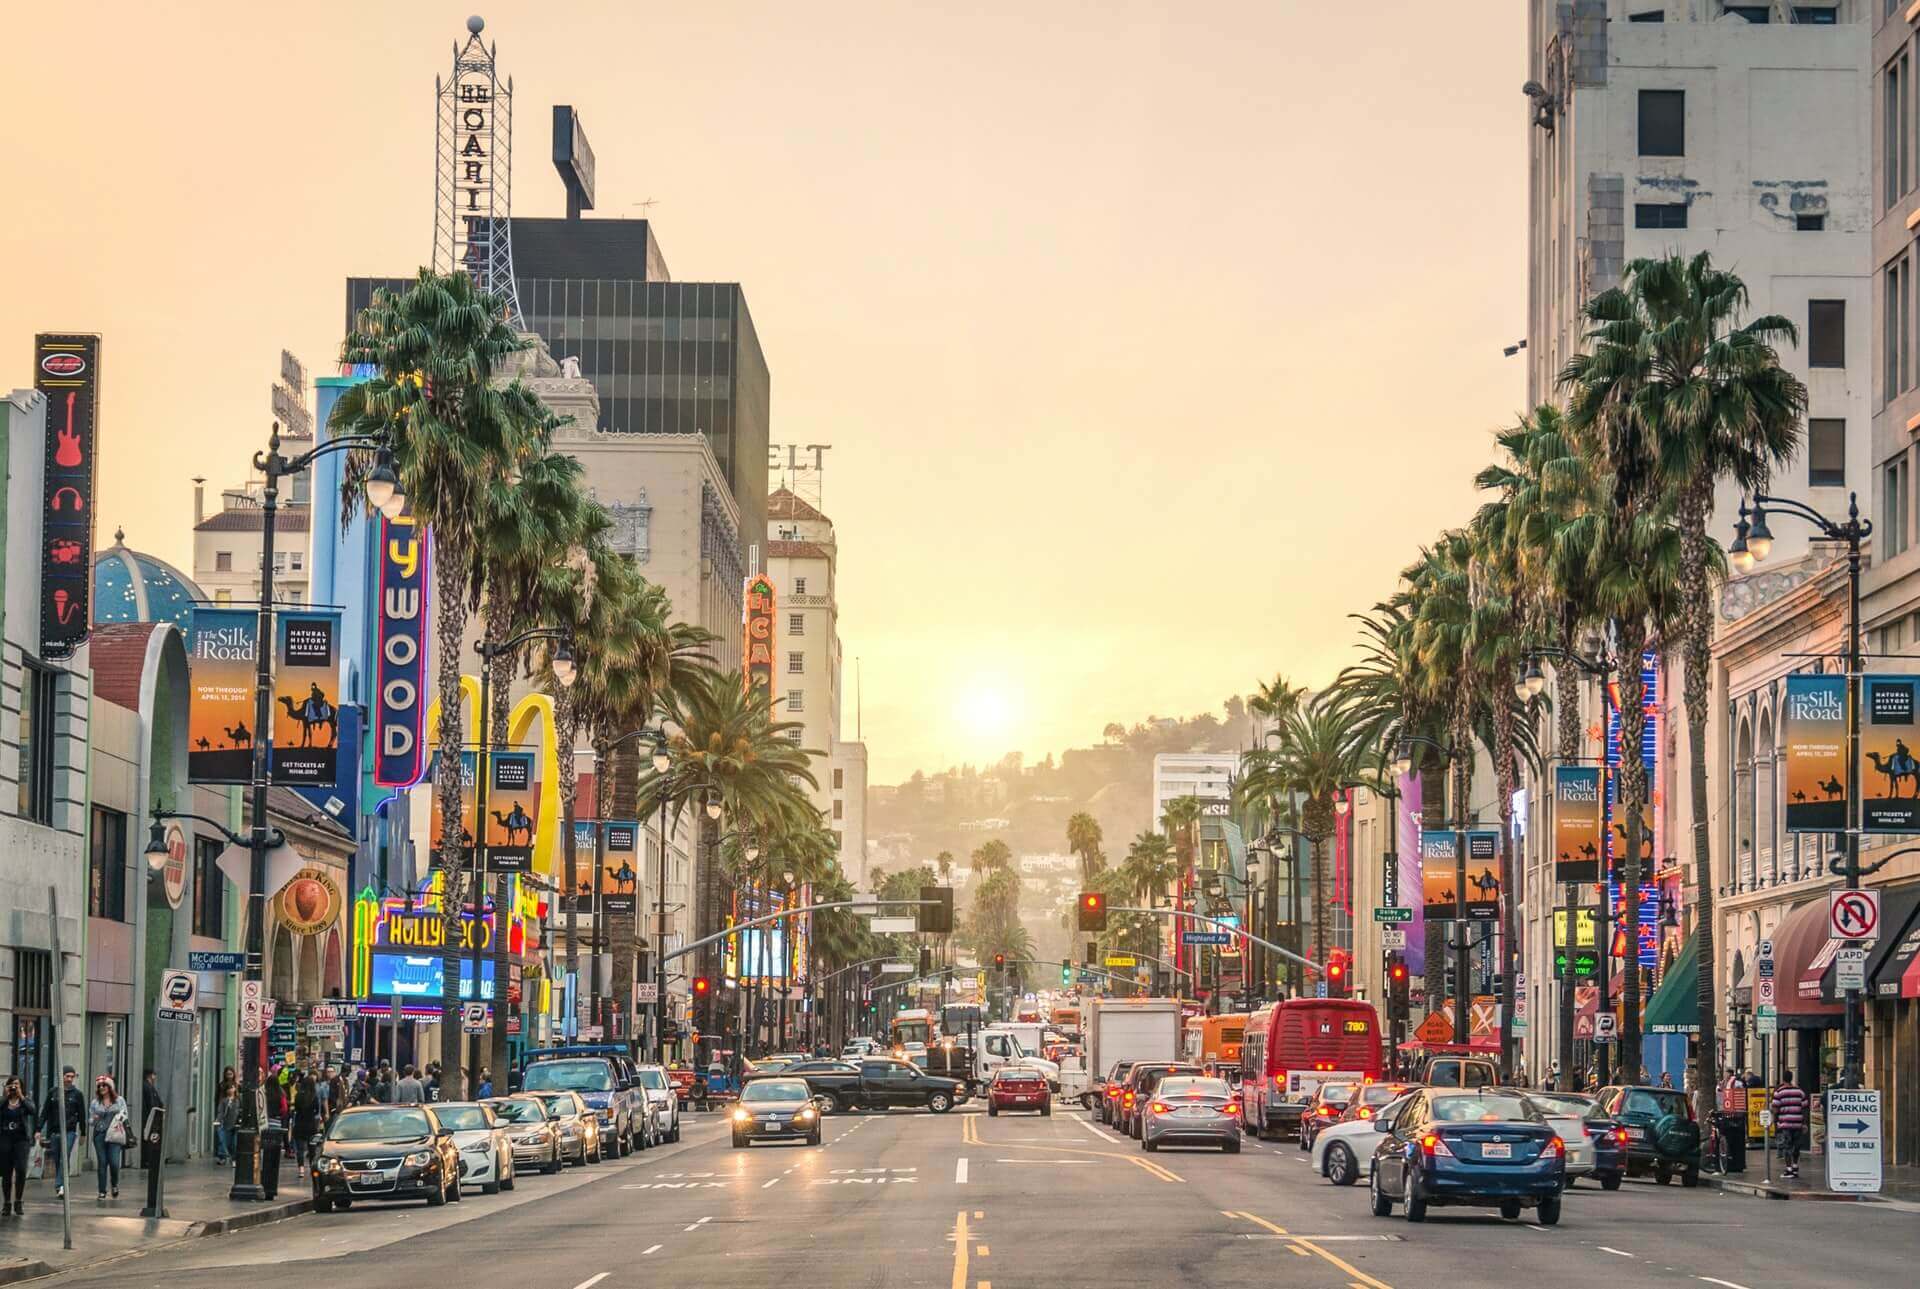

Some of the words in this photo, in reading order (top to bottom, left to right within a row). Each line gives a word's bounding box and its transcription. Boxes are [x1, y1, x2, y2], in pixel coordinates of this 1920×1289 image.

[751, 593, 771, 614] EL
[205, 630, 217, 640] The
[217, 627, 249, 646] Silk
[203, 640, 254, 660] Road
[1808, 690, 1838, 708] Silk
[1796, 702, 1843, 720] Road
[1572, 779, 1594, 792] Silk
[1563, 786, 1597, 801] Road
[1435, 840, 1452, 851] Silk
[1428, 847, 1455, 858] Road
[1186, 934, 1216, 943] Highland
[1217, 934, 1227, 942] Av
[191, 953, 234, 964] McCadden
[1838, 951, 1863, 960] LAPD
[160, 1010, 174, 1019] PAY
[175, 1012, 193, 1021] HERE
[314, 1007, 336, 1018] ATM
[1347, 1021, 1365, 1032] 780
[1831, 1094, 1877, 1103] PUBLIC
[1831, 1104, 1878, 1113] PARKING
[1834, 1141, 1846, 1149] PARK
